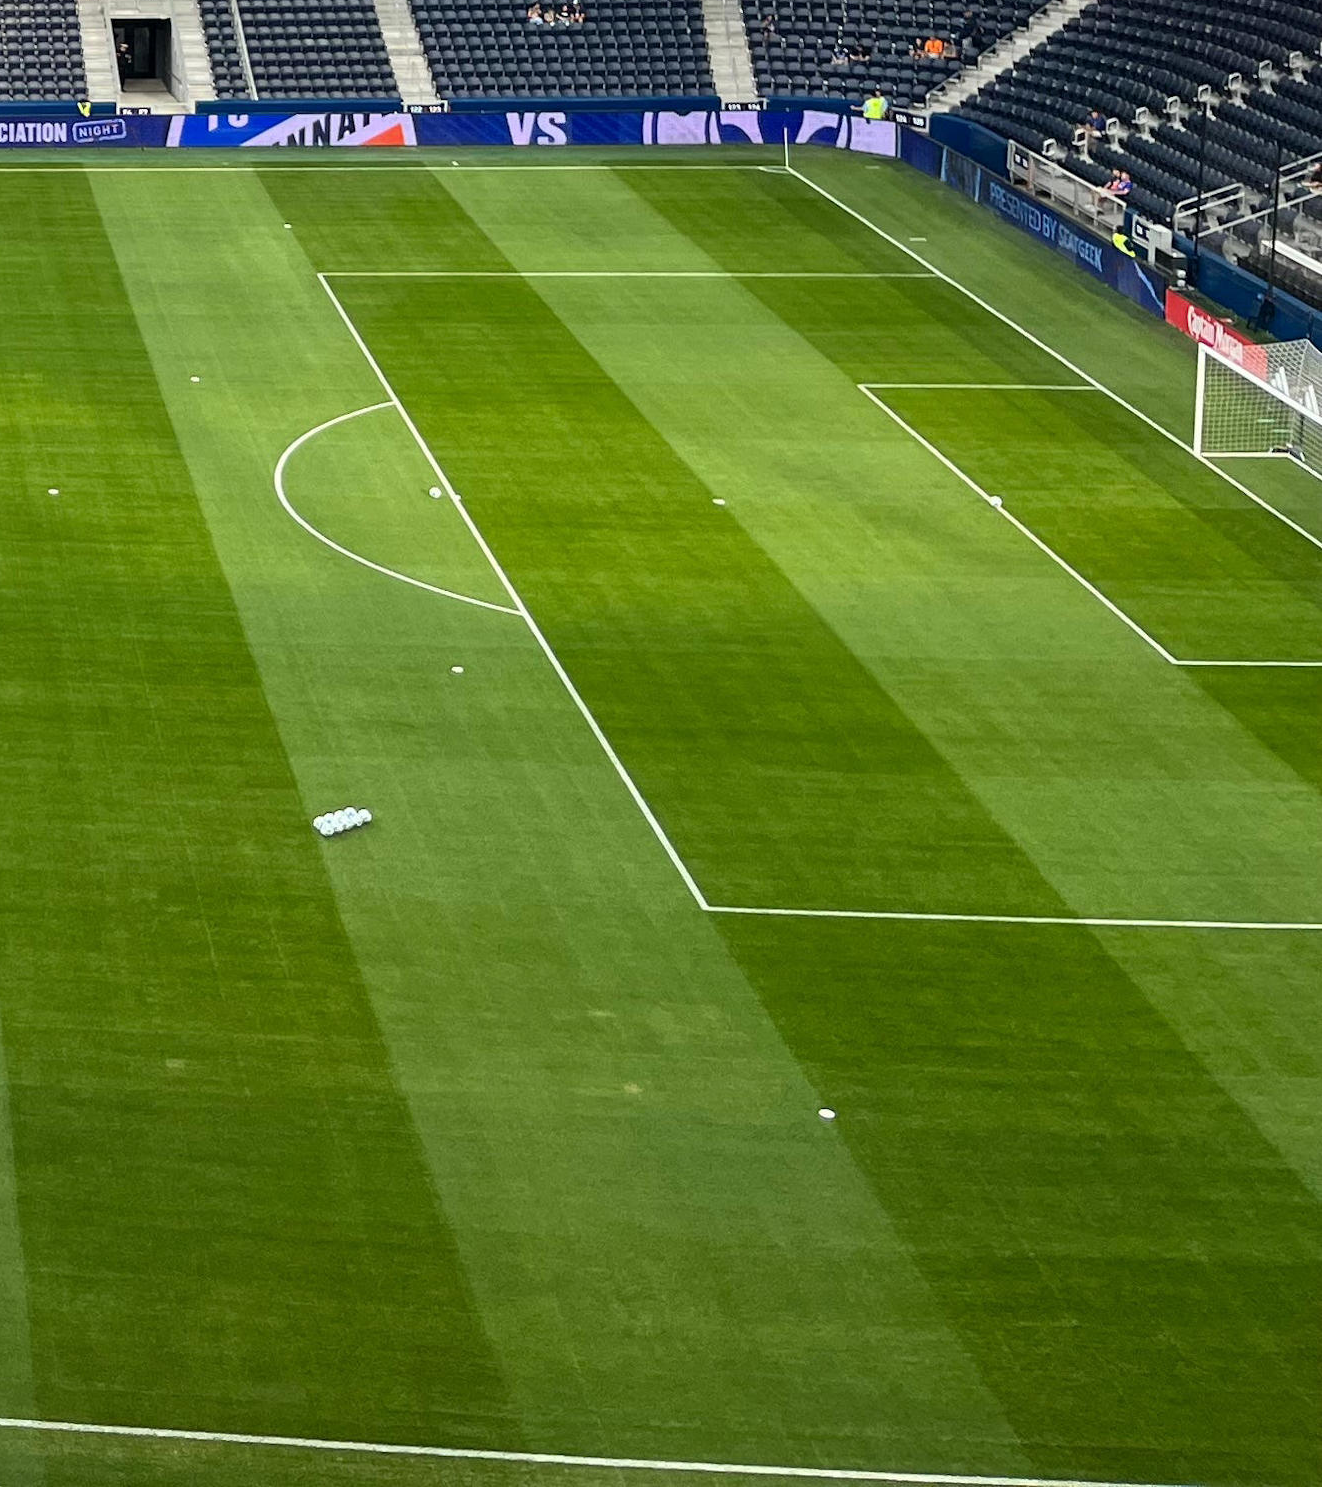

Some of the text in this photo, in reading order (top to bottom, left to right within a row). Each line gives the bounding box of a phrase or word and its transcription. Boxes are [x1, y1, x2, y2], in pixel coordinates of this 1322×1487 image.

[79, 123, 119, 137] NIGHT
[507, 112, 566, 146] VS
[989, 182, 1103, 273] PRESENTED BY SEATGEEK
